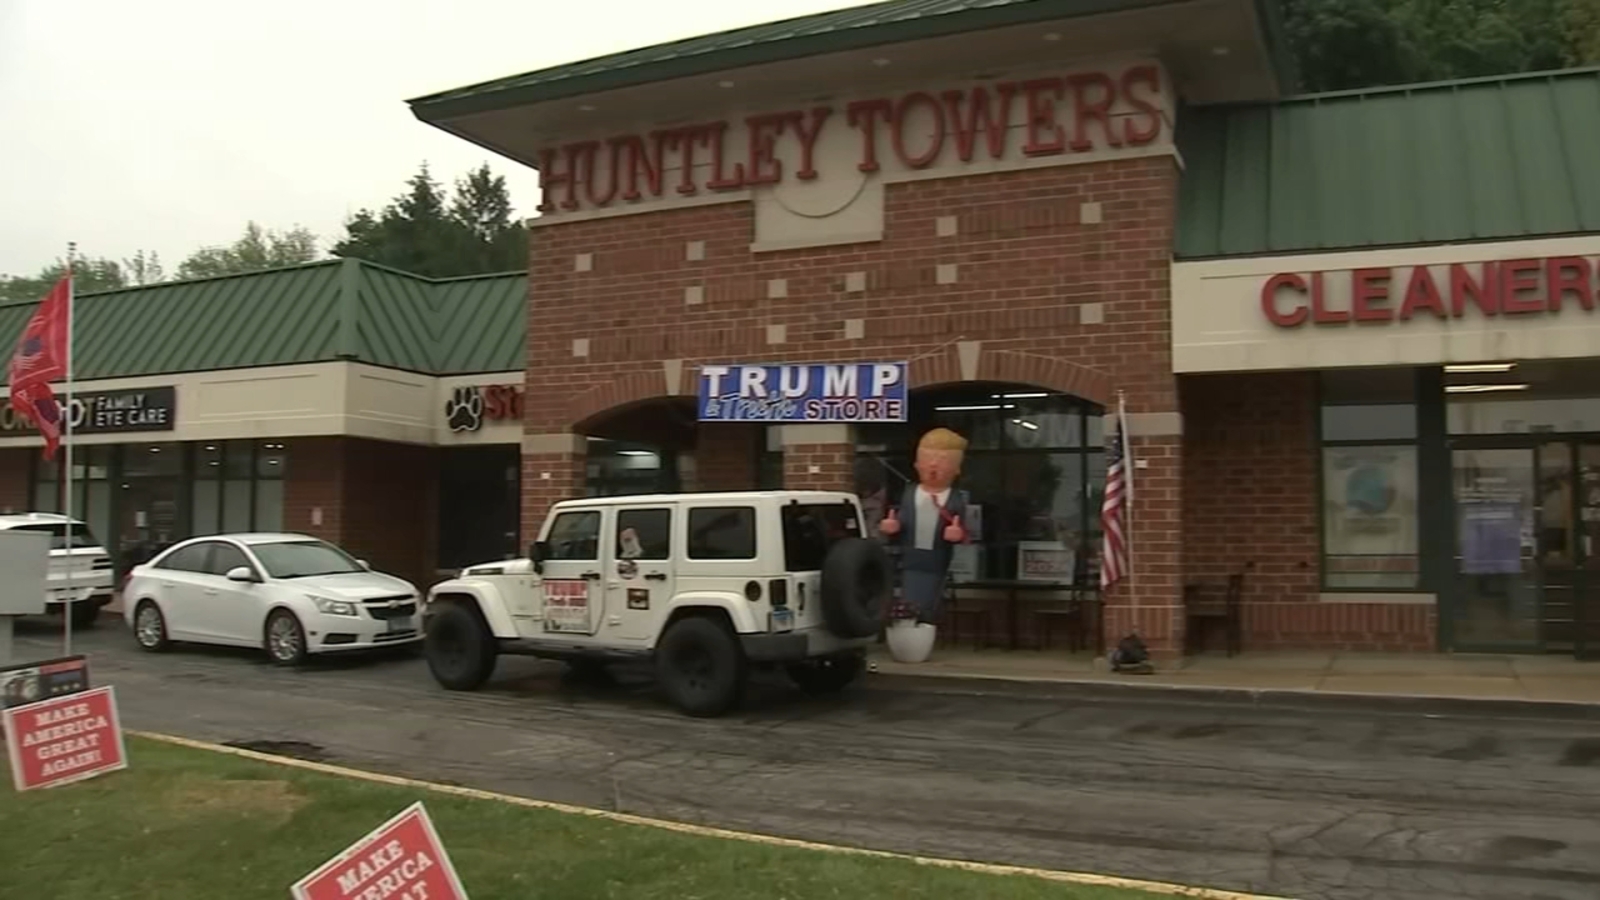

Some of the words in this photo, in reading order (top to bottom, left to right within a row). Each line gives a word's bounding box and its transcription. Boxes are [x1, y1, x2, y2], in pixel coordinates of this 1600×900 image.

[536, 105, 834, 213] HUNTLEY
[847, 65, 1165, 170] TOWERS
[1261, 255, 1600, 327] CLEANER
[703, 364, 900, 397] TRUMP
[96, 394, 145, 410] FAMILY
[96, 410, 124, 426] EYE
[128, 408, 167, 425] CARE
[805, 399, 901, 420] STORE
[35, 702, 91, 727] MAKE
[22, 715, 108, 747] AMERICA
[37, 733, 99, 760] GREAT
[336, 839, 405, 895] MAKE
[352, 851, 434, 900] ERICA
